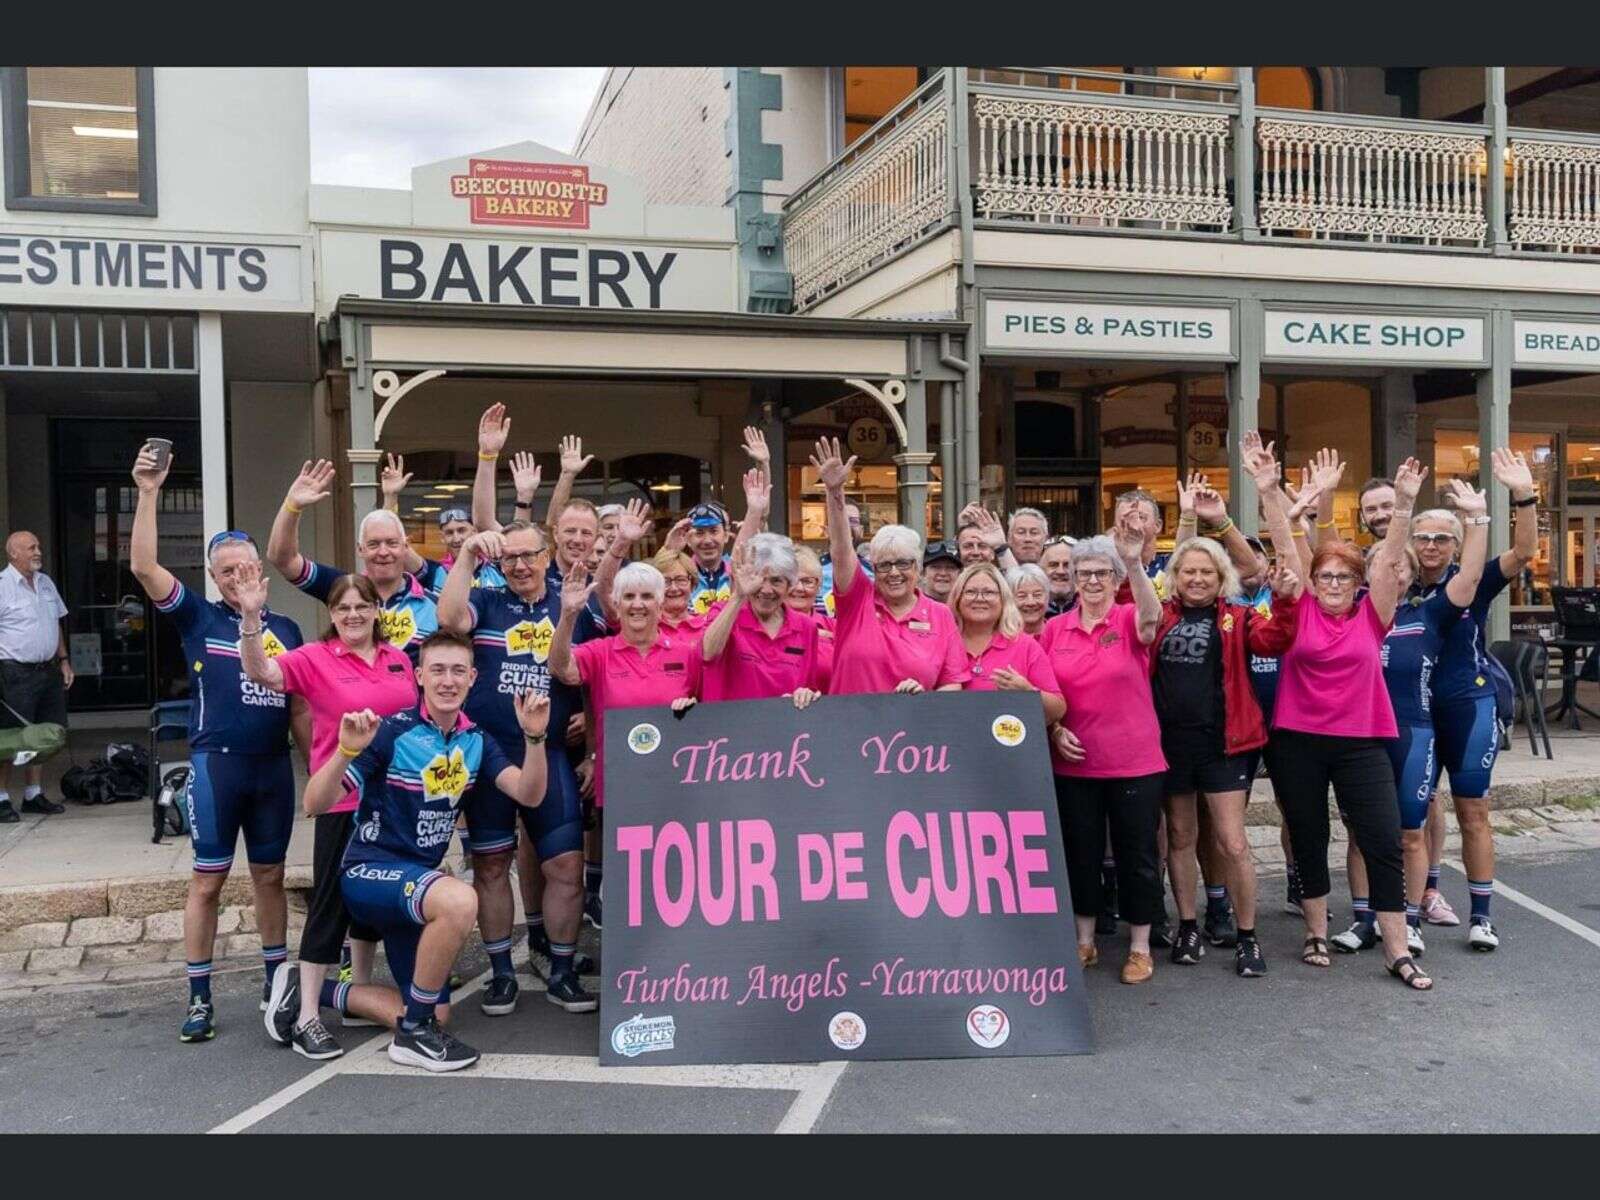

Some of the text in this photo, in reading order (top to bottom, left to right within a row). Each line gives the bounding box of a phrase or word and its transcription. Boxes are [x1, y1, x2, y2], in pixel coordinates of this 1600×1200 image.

[453, 176, 606, 203] BEECHWORTH
[486, 198, 575, 218] BAKERY
[380, 239, 677, 309] BAKERY
[1004, 314, 1213, 340] PIES & PASTIES
[1283, 321, 1466, 348] CAKE SHOP
[1525, 333, 1600, 352] BREAD
[856, 426, 878, 442] 36
[1192, 430, 1214, 446] 36
[499, 670, 552, 689] CURE
[241, 694, 286, 708] CANCER
[672, 731, 951, 788] Thank You
[359, 867, 404, 880] LEXUS
[616, 810, 1059, 928] TOUR DE CURE
[616, 962, 730, 1004] Turban
[736, 957, 848, 1012] Angels
